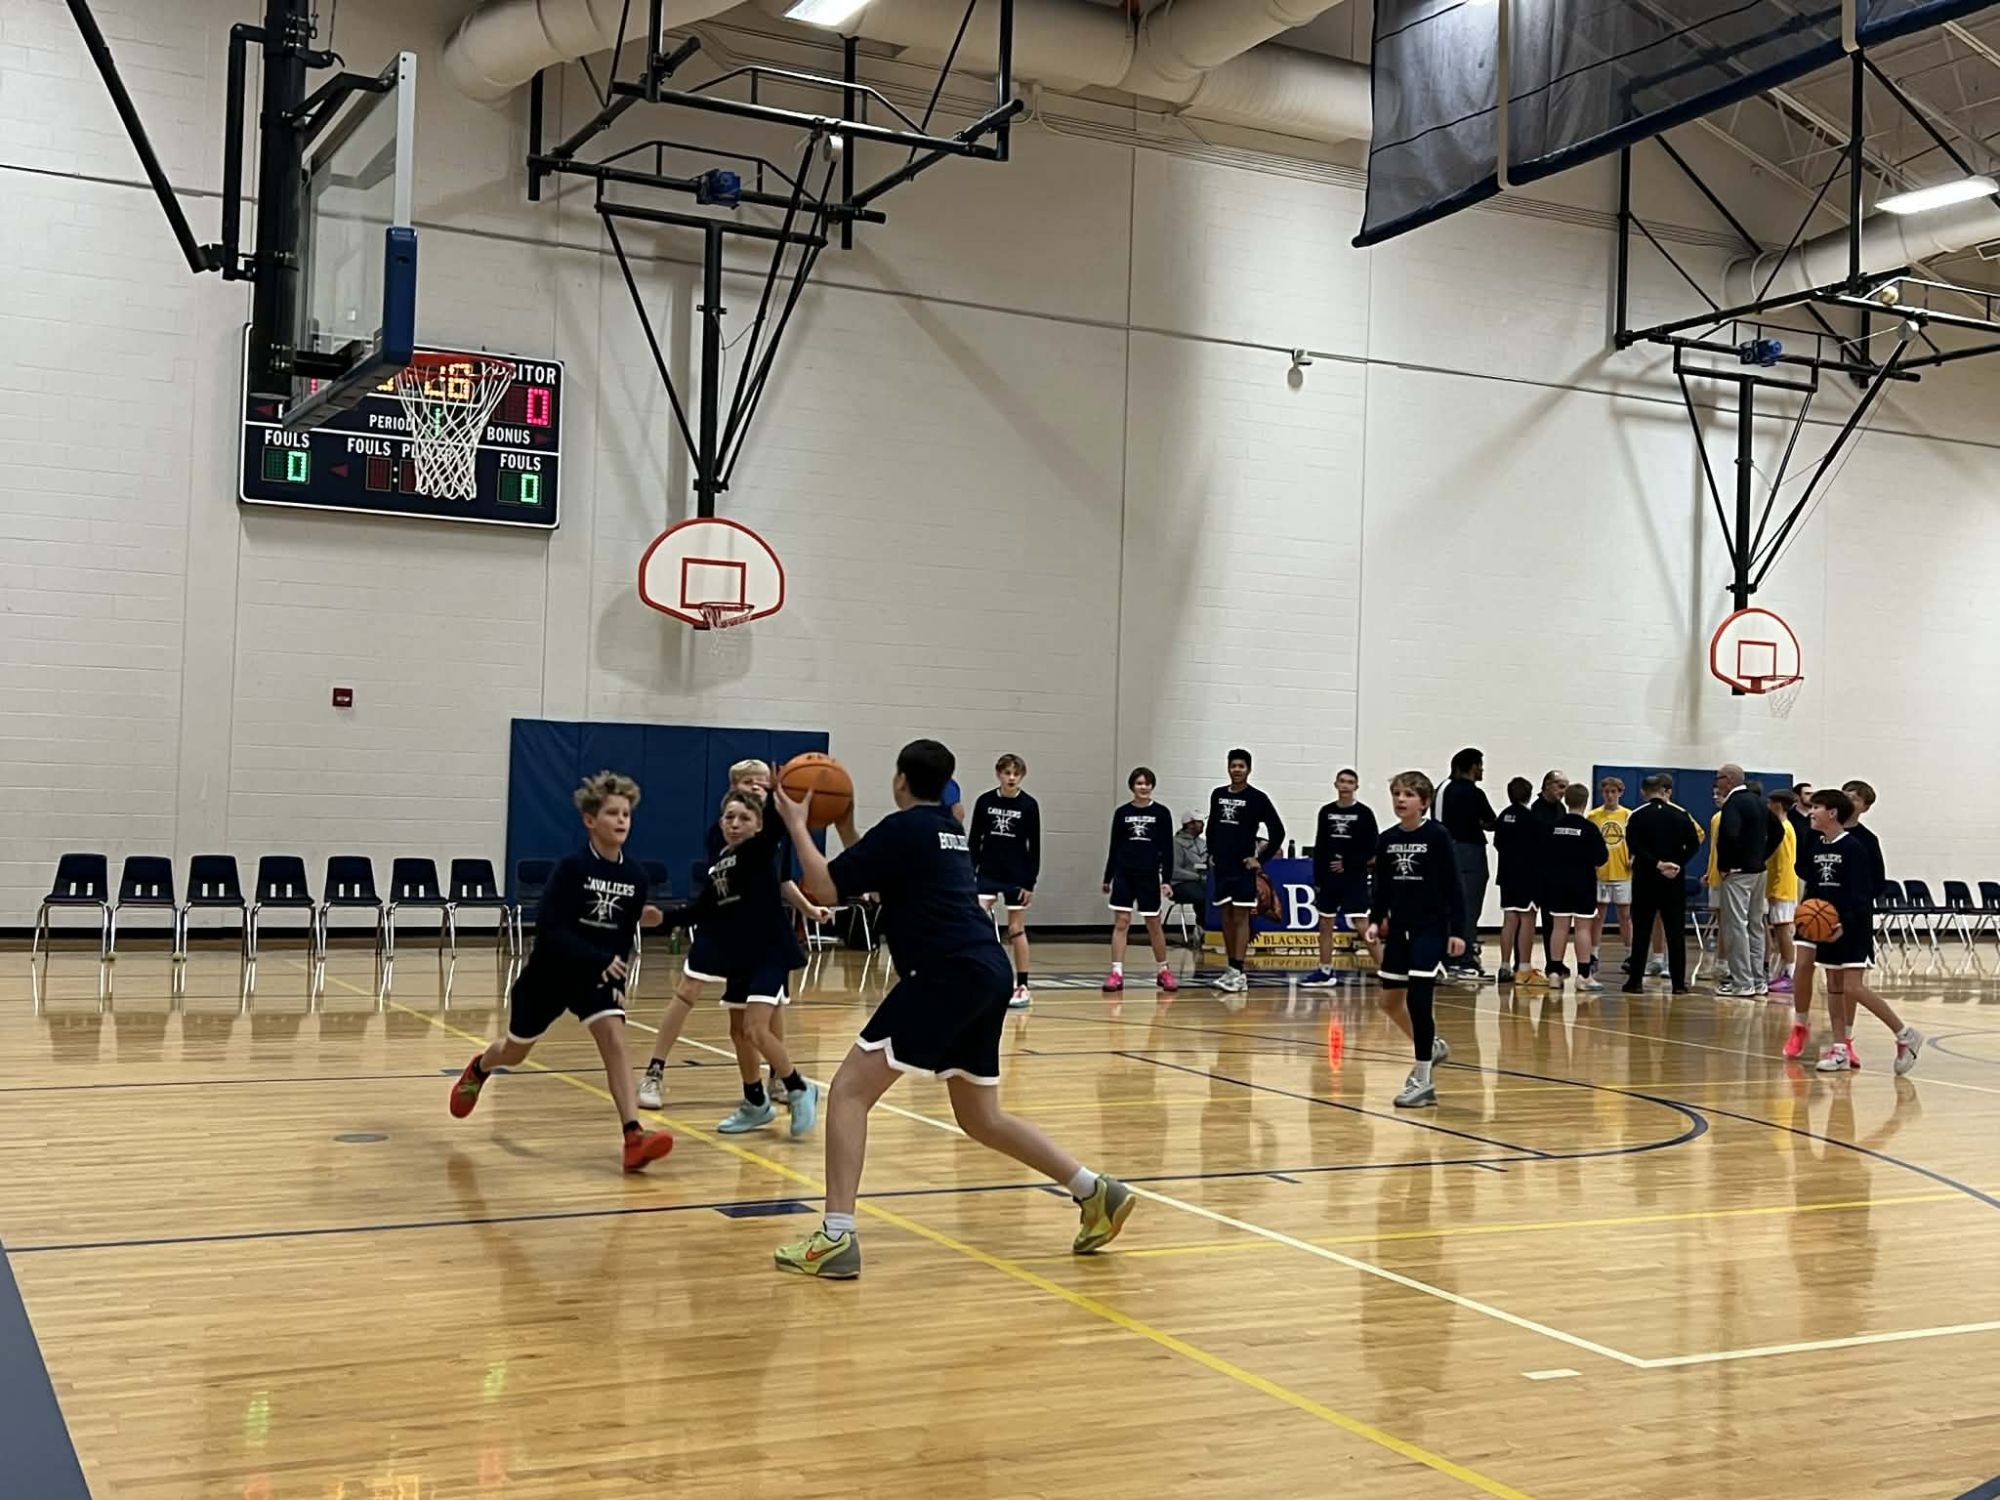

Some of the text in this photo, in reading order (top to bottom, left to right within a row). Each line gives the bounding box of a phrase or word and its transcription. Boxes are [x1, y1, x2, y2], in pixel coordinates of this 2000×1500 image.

[369, 414, 412, 431] PERIOD
[265, 429, 310, 448] FOULS
[487, 427, 530, 444] BONUS
[347, 438, 392, 456] FOULS
[287, 450, 307, 482] 0
[500, 453, 541, 471] FOULS
[520, 473, 538, 503] 0
[1263, 935, 1344, 946] BLACKSBG
